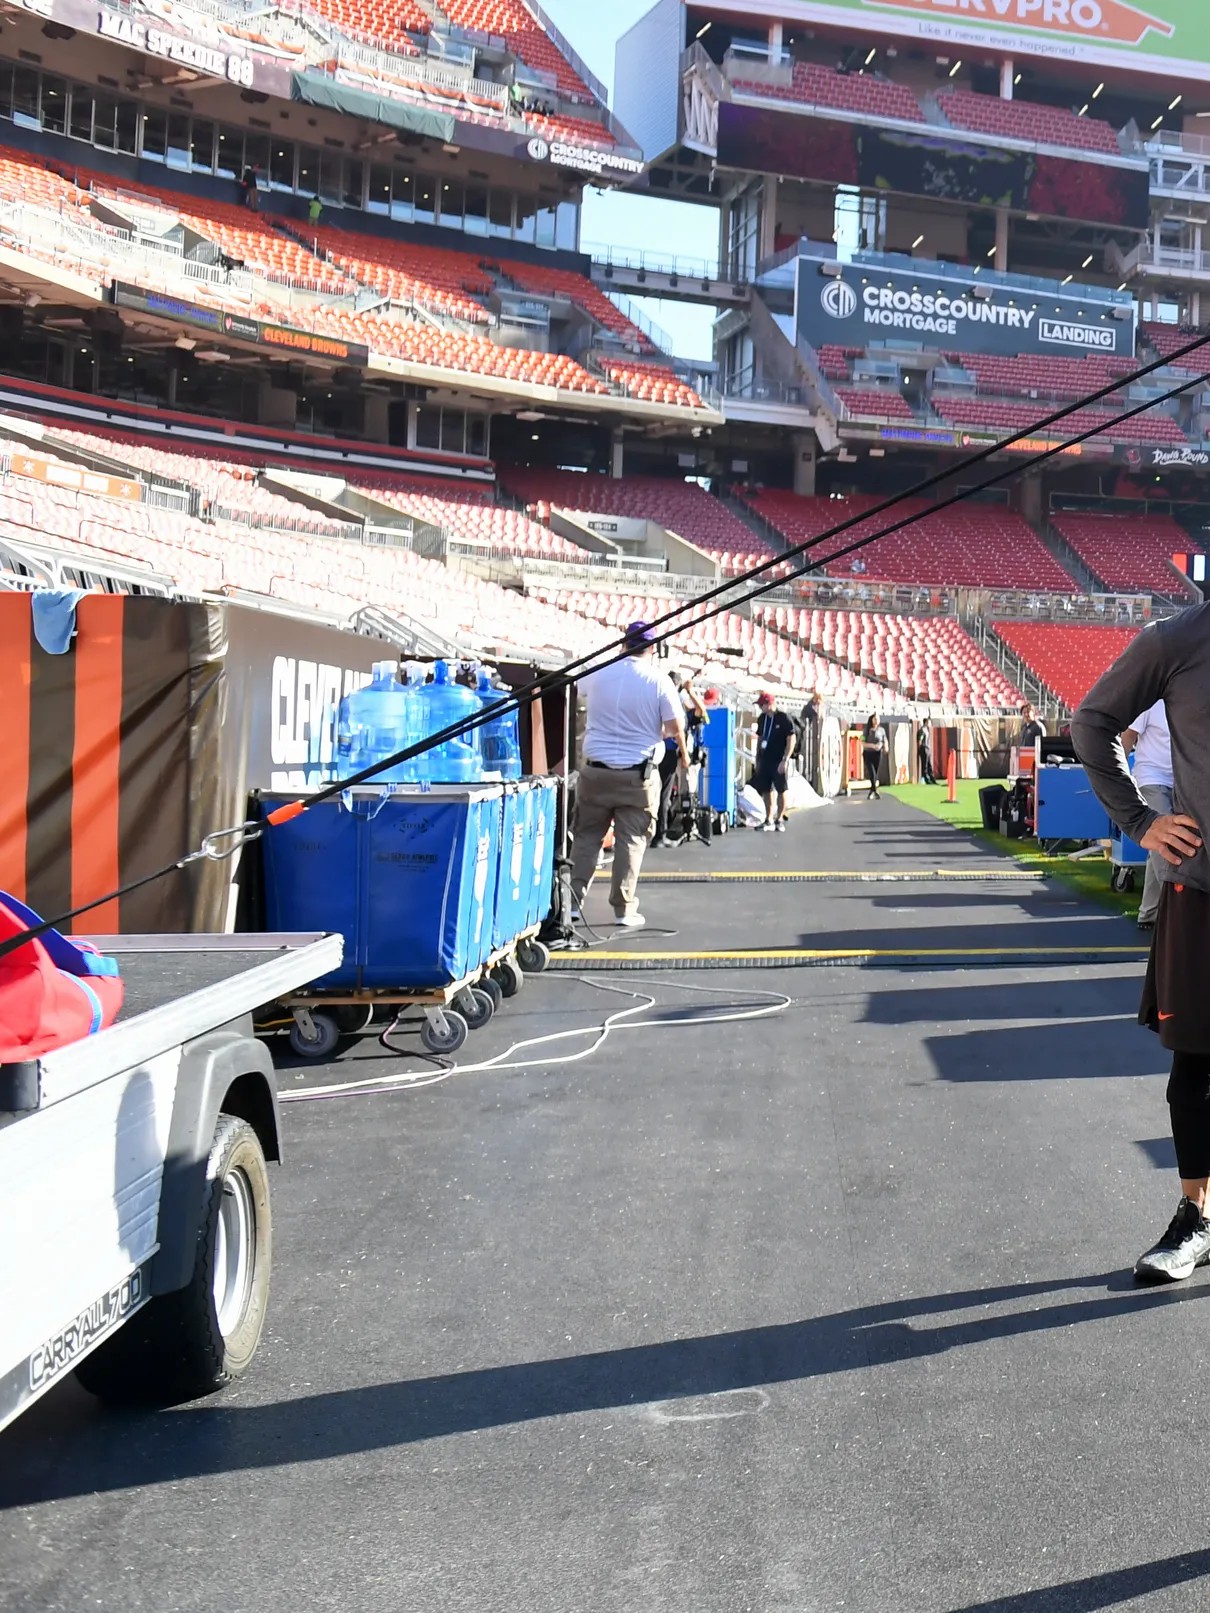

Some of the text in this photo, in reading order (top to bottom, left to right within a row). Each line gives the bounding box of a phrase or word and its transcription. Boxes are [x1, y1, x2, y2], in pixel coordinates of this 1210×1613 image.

[913, 0, 1103, 28] VPRO
[98, 12, 145, 47] MAC
[146, 29, 226, 75] SPEEDIE
[918, 23, 941, 37] Like
[955, 30, 986, 43] never
[989, 36, 1016, 48] even
[549, 142, 645, 174] CROSSCOUNTRY
[862, 286, 1036, 329] CROSSCOUNTRY
[863, 307, 957, 334] MORTGAGE
[264, 328, 311, 350] CLEVELAND
[311, 338, 348, 358] BROWNS
[1042, 322, 1113, 346] LANDING
[271, 656, 373, 764] CLEVE
[29, 1268, 142, 1391] CARRYALL 700
